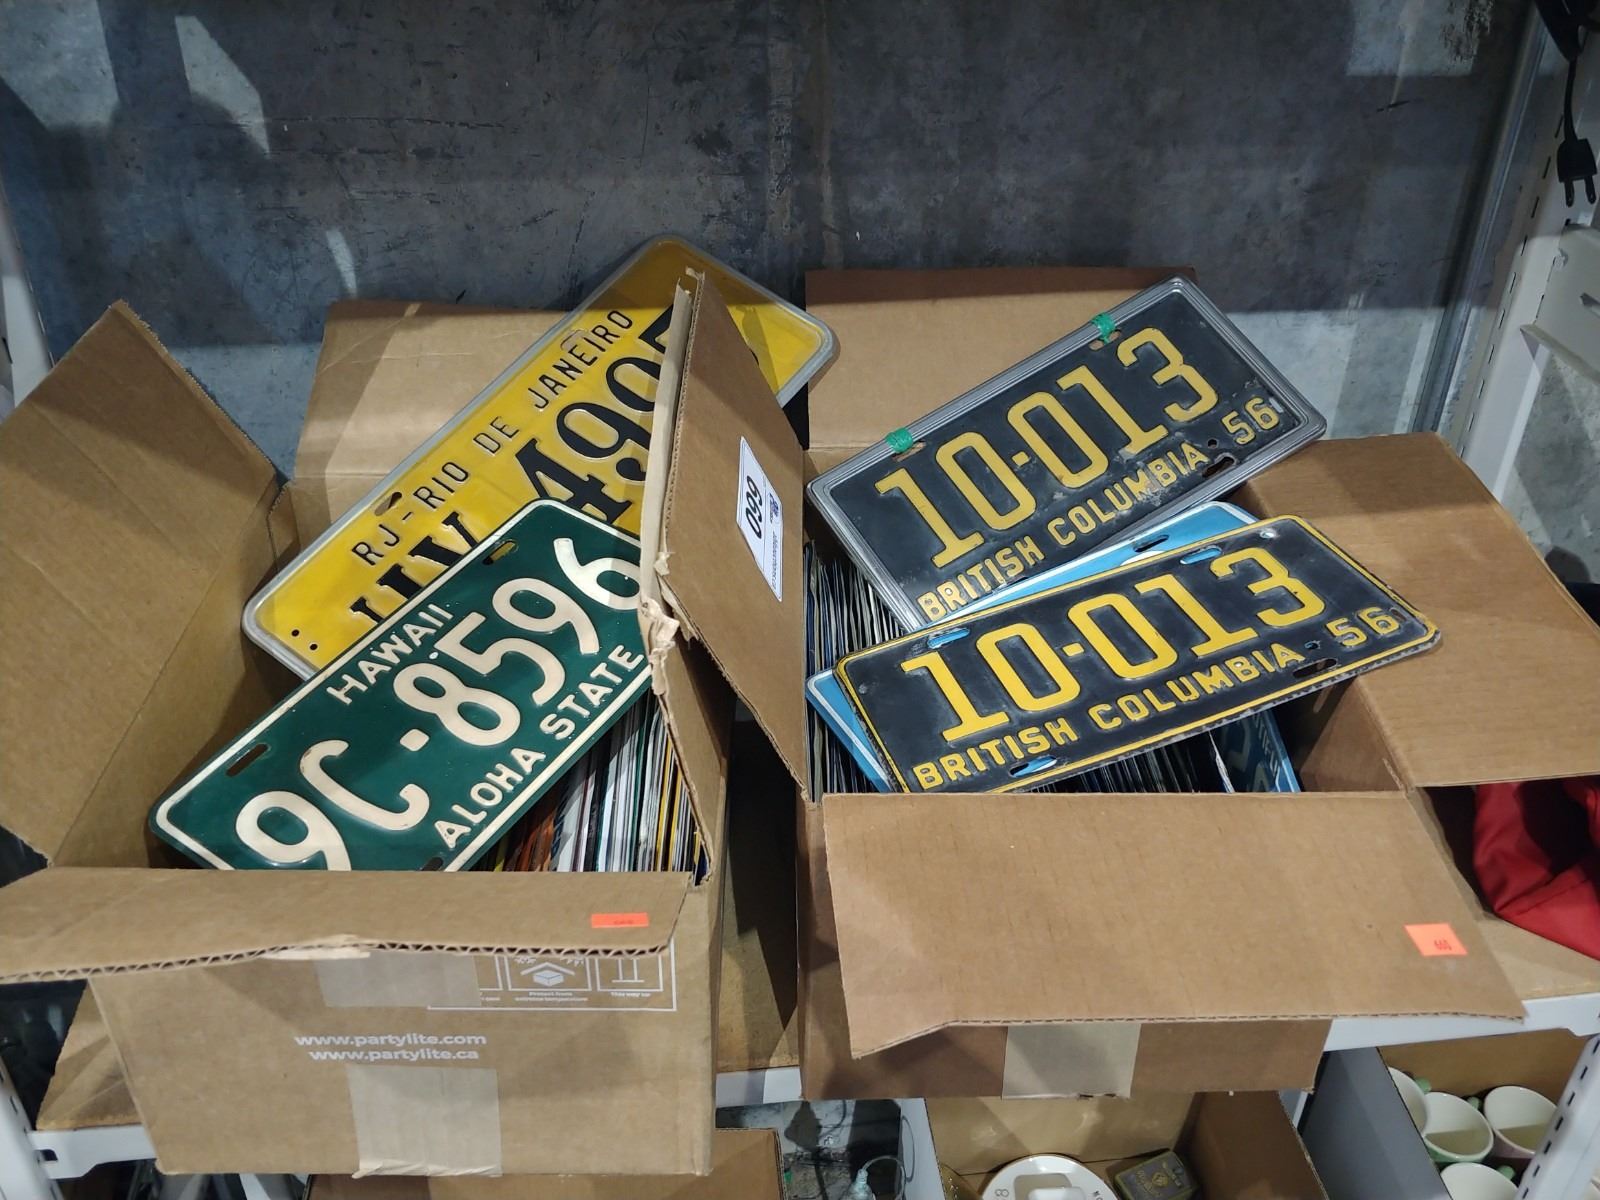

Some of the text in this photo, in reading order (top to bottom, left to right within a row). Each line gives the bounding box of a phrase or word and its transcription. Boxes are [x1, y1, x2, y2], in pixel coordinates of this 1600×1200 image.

[472, 415, 520, 454] DE
[527, 310, 633, 411] JANEIRO
[515, 303, 674, 524] 49
[874, 327, 1220, 568] 10-013
[745, 475, 763, 540] 660
[917, 397, 1280, 621] BRITISH COLUMBIA 56
[326, 603, 454, 705] HAWAII
[900, 546, 1326, 742] 10-013
[912, 605, 1399, 791] BRITISH COLUMBIA 56
[434, 644, 645, 849] ALOHA STATE
[293, 1033, 487, 1048] www.partylite.com
[309, 1049, 479, 1062] www.partylite.ca
